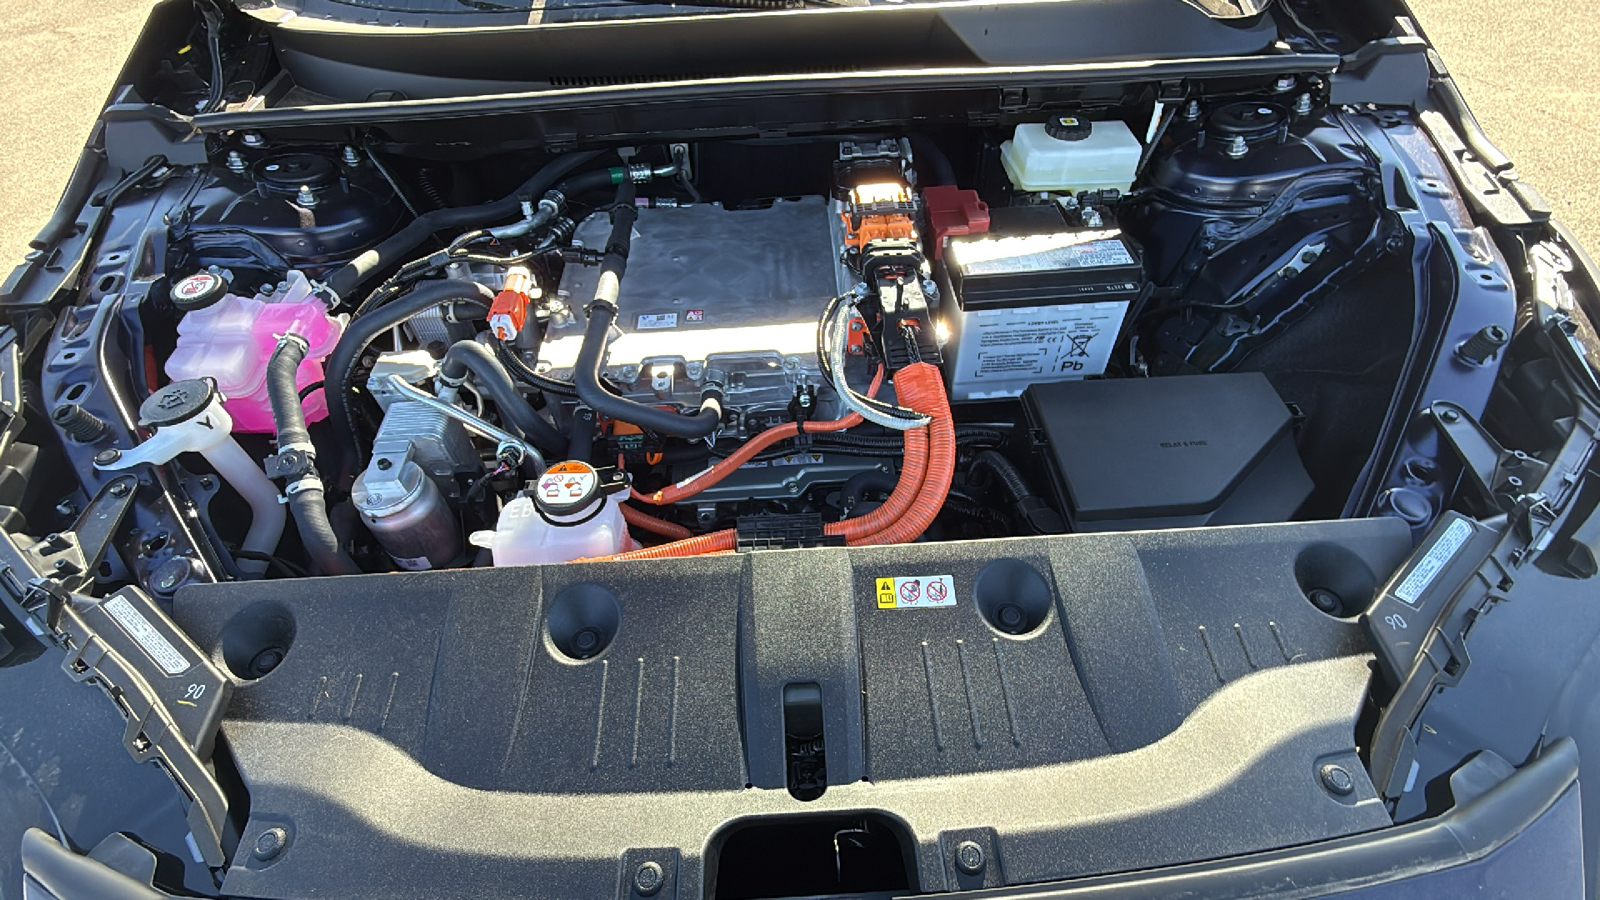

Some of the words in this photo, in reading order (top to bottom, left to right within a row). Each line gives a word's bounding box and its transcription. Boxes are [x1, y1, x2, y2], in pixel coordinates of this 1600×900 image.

[1061, 361, 1084, 372] Pb
[1384, 613, 1408, 630] 90
[183, 683, 206, 699] 90
